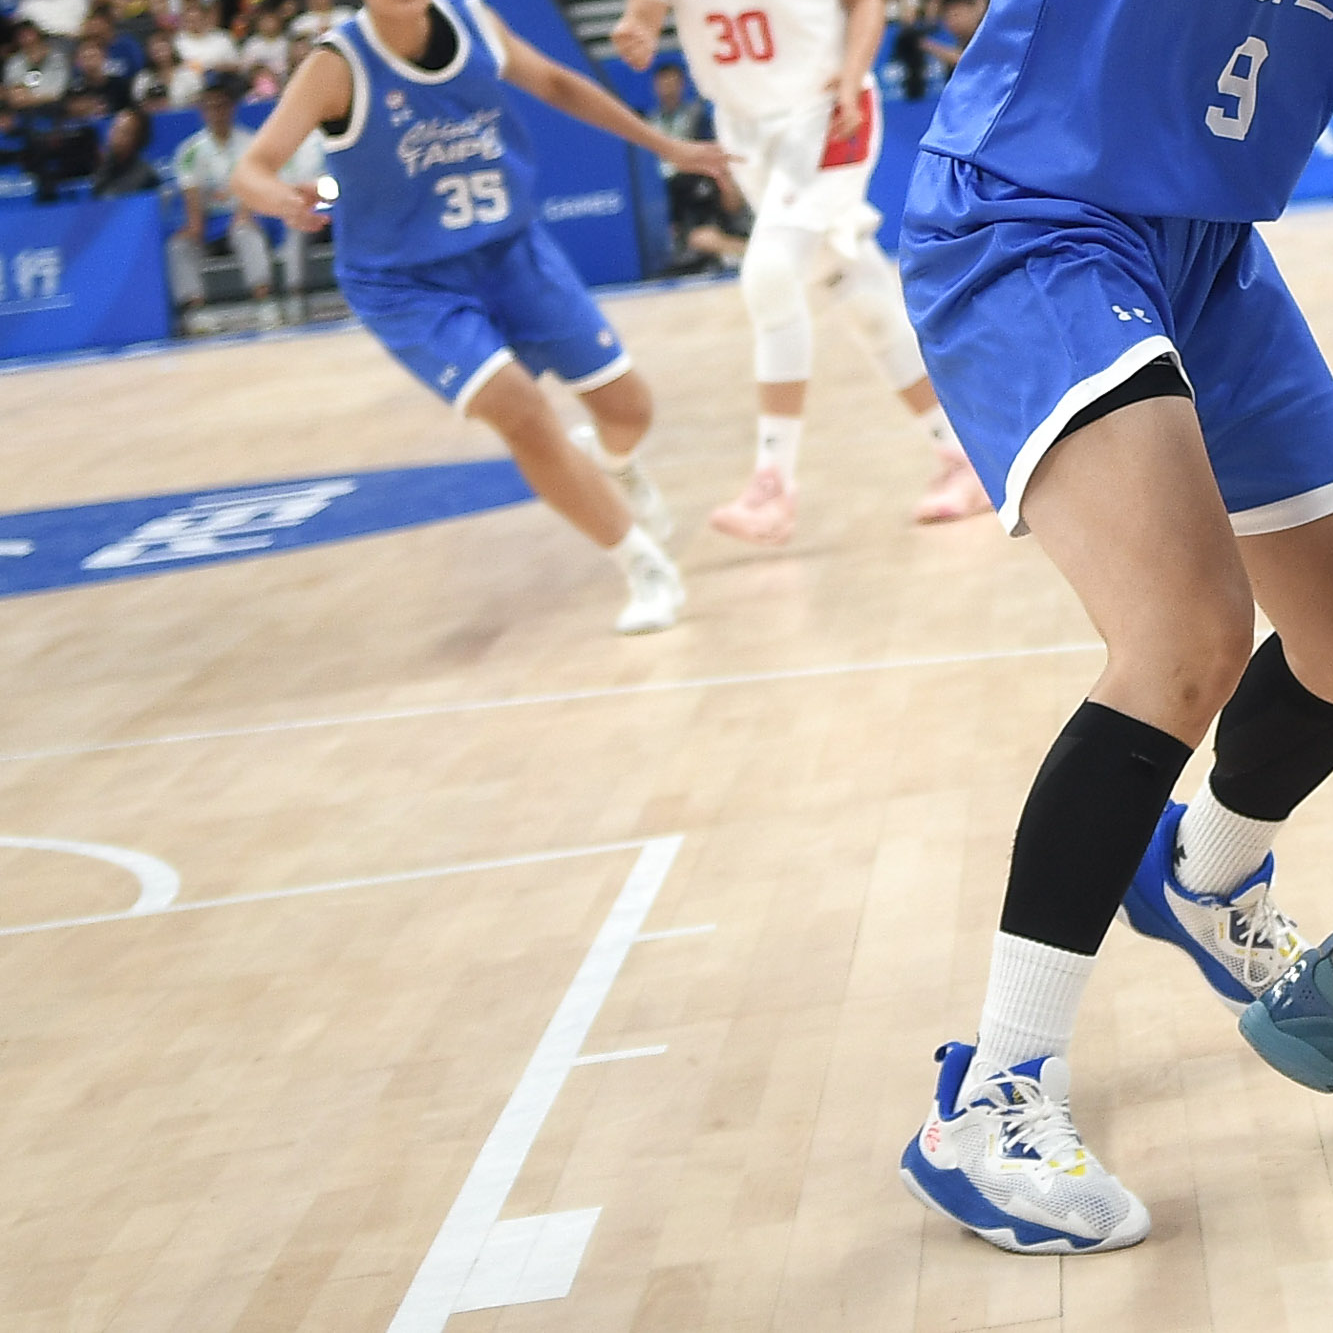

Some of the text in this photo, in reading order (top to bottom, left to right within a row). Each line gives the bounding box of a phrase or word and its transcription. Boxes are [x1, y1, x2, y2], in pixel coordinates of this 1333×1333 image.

[704, 9, 774, 64] 30
[1205, 36, 1269, 141] 9
[434, 169, 510, 230] 35
